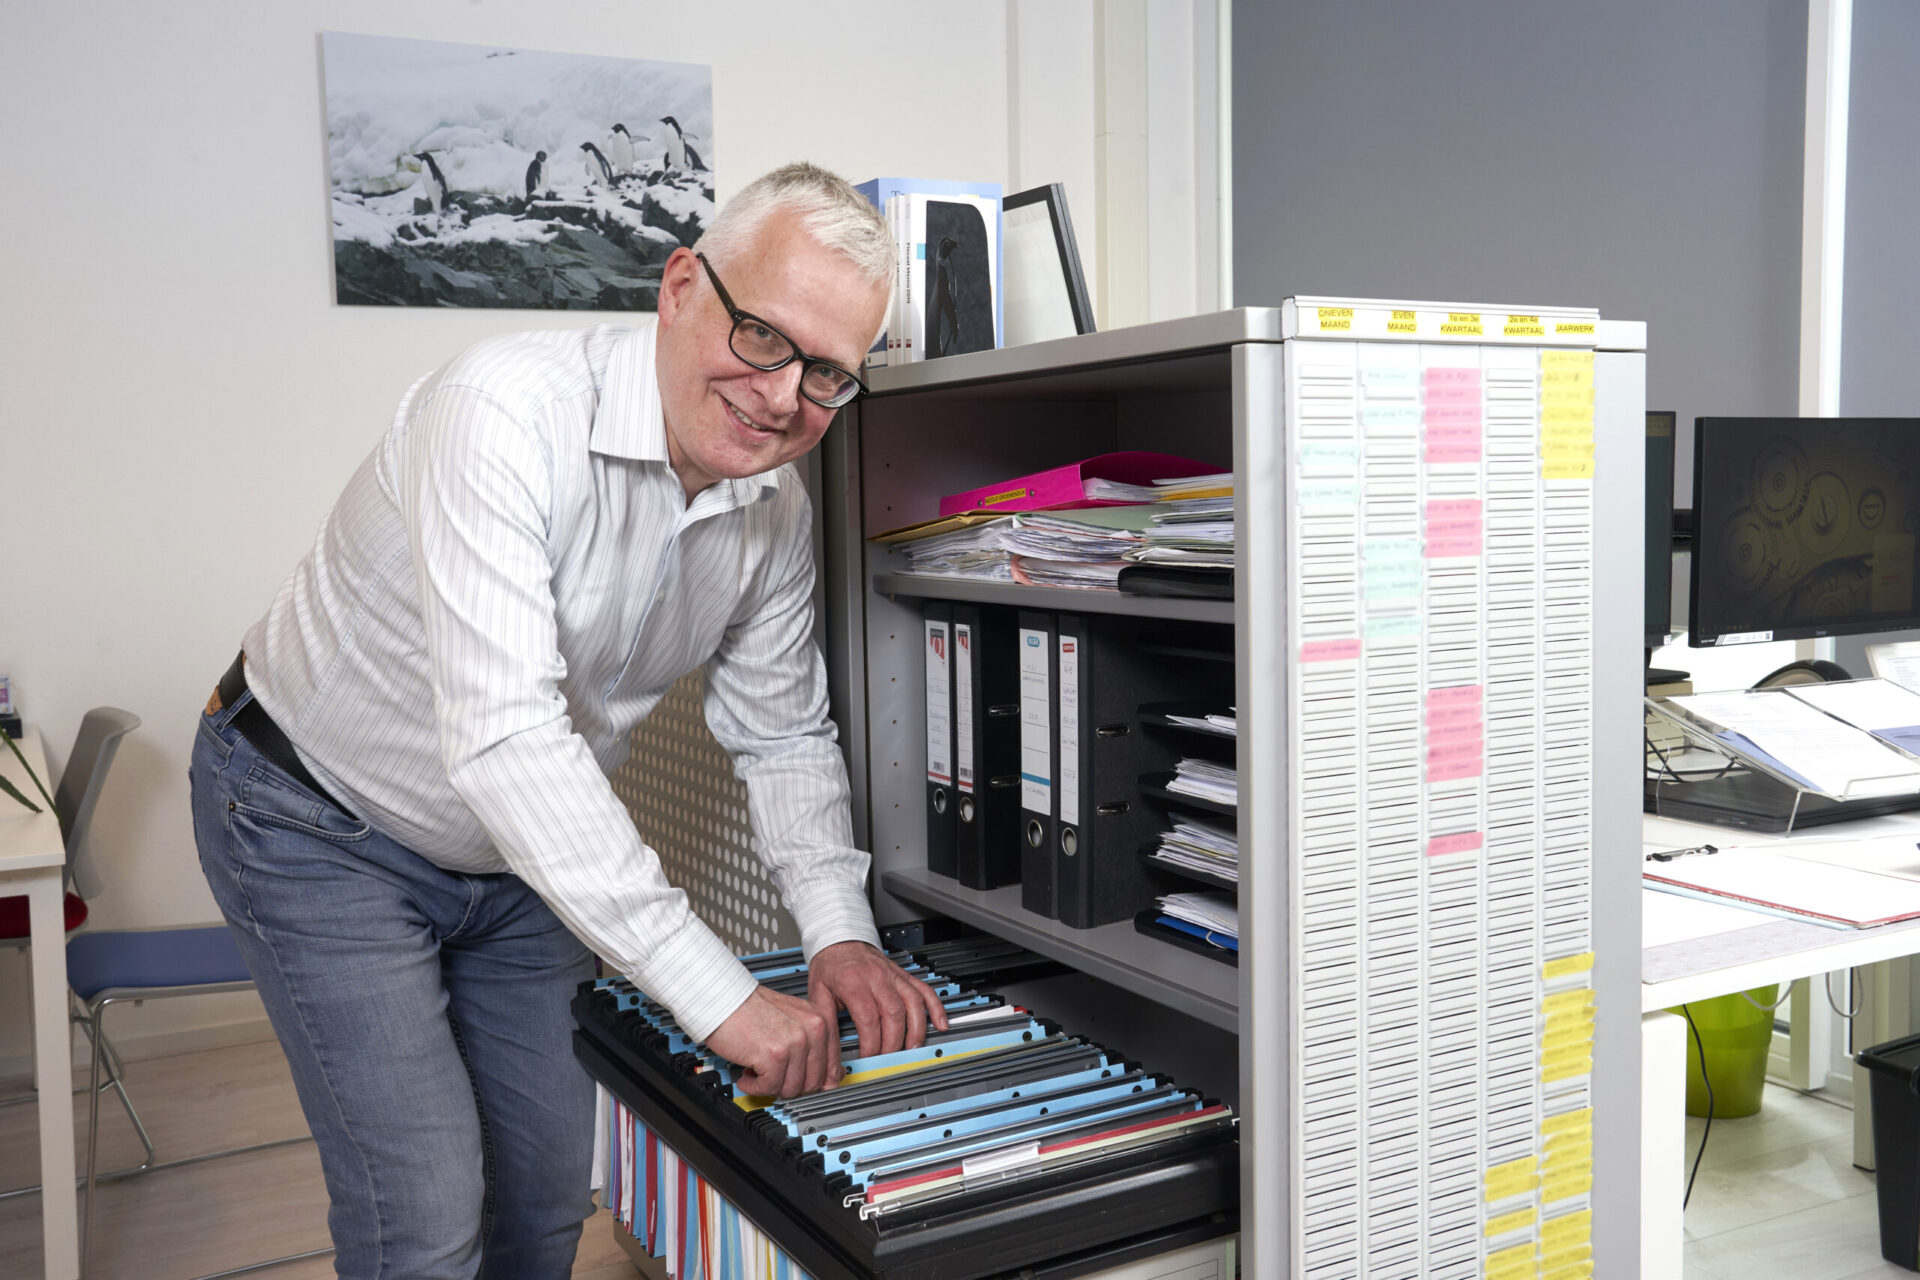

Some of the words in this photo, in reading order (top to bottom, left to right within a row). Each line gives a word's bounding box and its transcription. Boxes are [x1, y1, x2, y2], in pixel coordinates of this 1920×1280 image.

[1318, 309, 1353, 317] ONEVEN
[1320, 320, 1351, 329] MAAND
[1387, 323, 1416, 332] MAAND
[1440, 325, 1482, 334] KWARTAAL
[1504, 327, 1544, 335] KWARTAAL
[1555, 325, 1594, 333] JAARWERK
